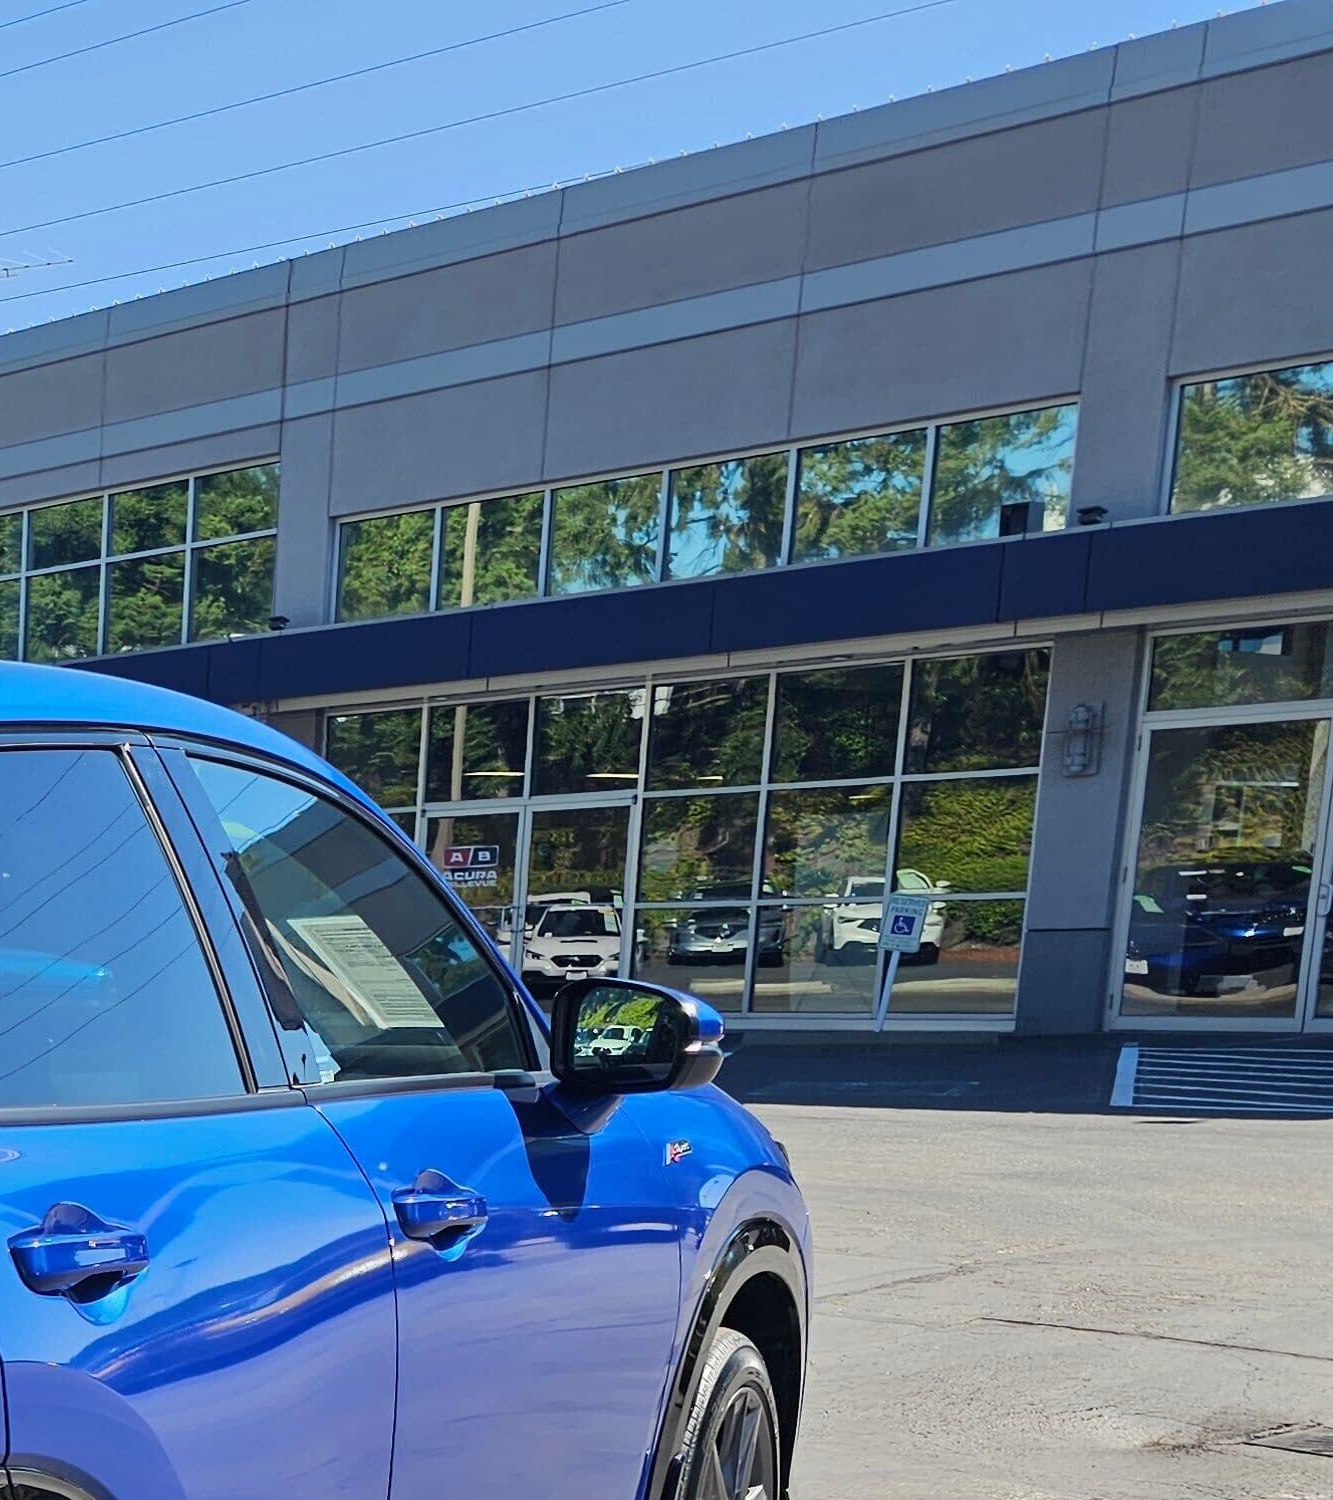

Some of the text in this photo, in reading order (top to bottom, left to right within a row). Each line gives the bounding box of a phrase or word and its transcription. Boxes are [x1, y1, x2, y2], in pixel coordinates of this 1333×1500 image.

[450, 851, 491, 863] A B
[443, 870, 497, 880] ACURA
